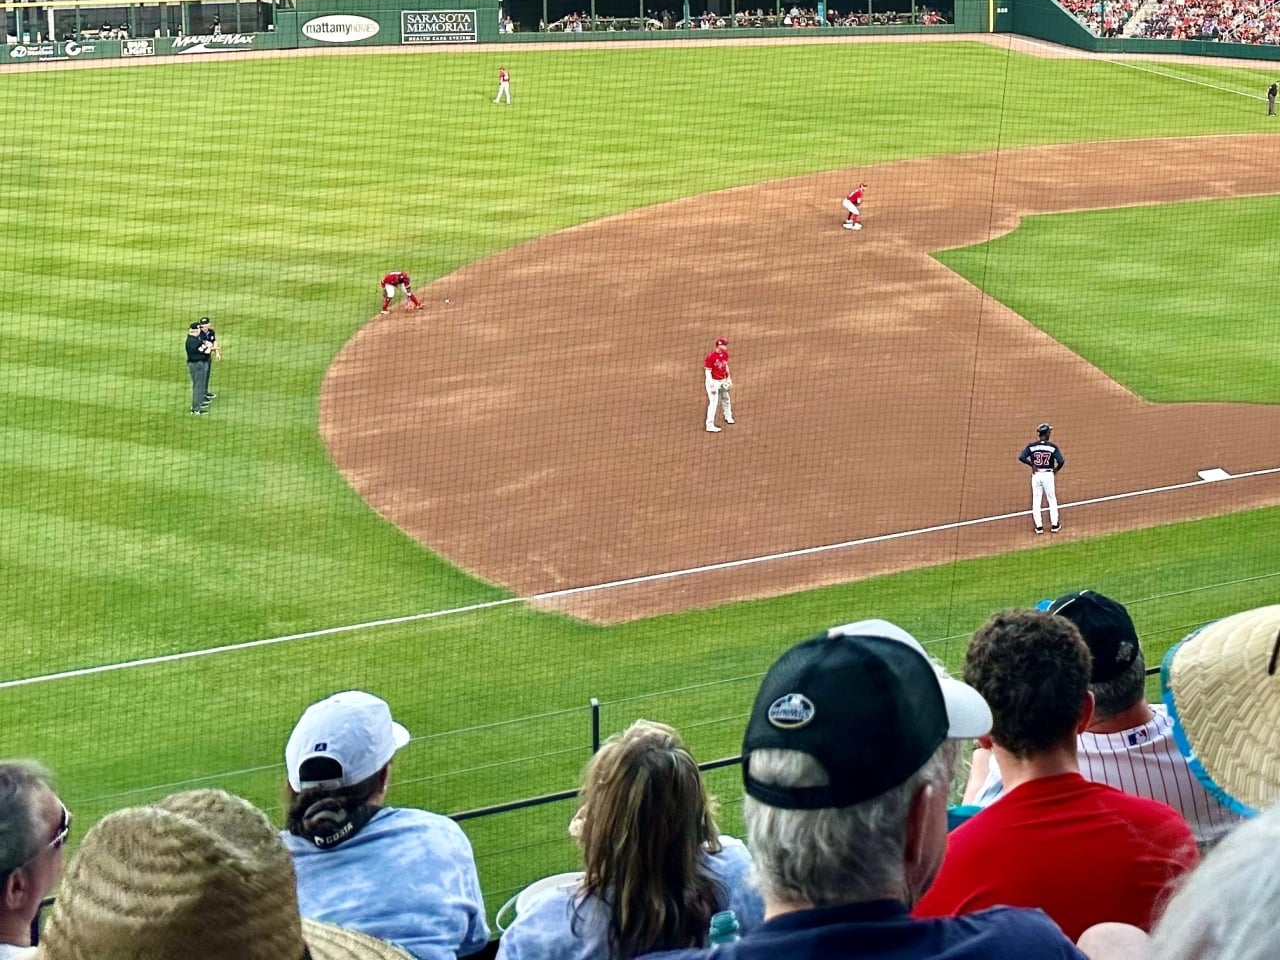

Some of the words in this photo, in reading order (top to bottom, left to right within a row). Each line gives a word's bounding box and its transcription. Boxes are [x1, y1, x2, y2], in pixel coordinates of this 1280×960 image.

[407, 13, 472, 23] SARASOTA
[407, 23, 472, 33] MEMORIAL
[1033, 451, 1051, 466] 37
[325, 821, 354, 844] COSTA
